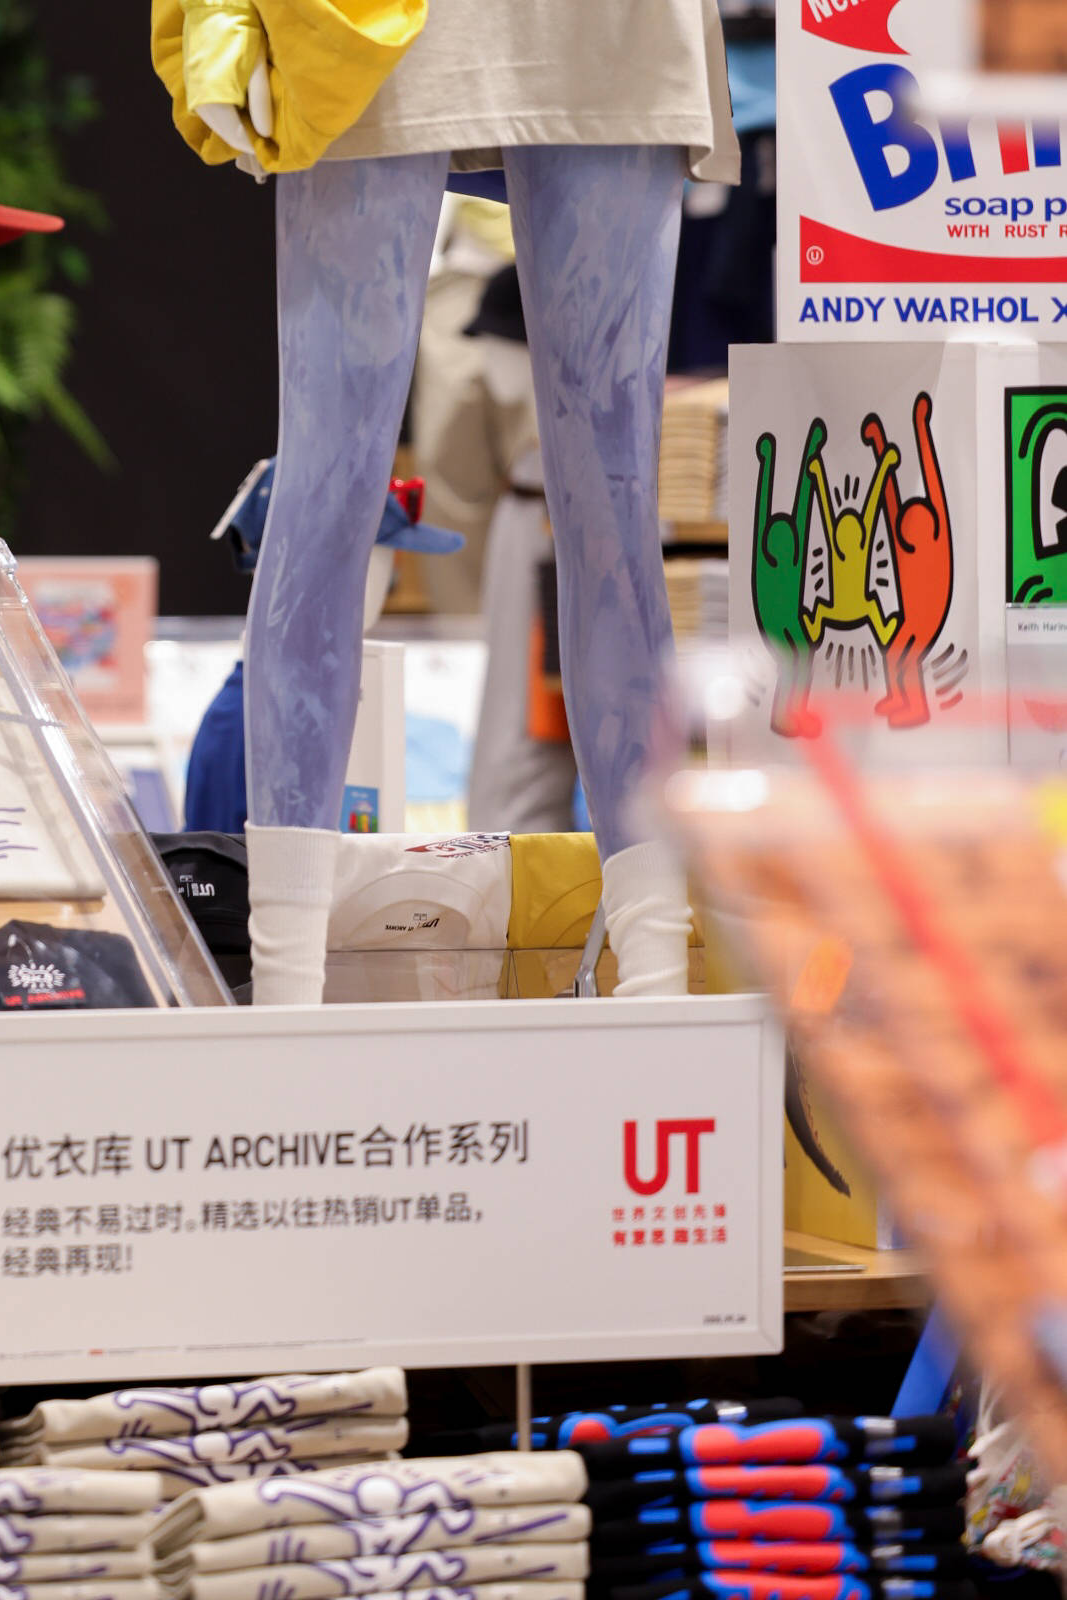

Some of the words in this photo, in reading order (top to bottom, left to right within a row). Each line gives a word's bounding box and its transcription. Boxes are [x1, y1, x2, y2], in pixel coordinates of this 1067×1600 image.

[944, 197, 1034, 222] soap
[947, 224, 989, 238] WITH
[1004, 224, 1048, 238] RUST
[799, 297, 886, 323] ANDY
[894, 297, 1039, 323] WARHOL
[1, 1131, 132, 1181] 优衣库
[145, 1136, 191, 1171] UT
[624, 1117, 716, 1196] UT
